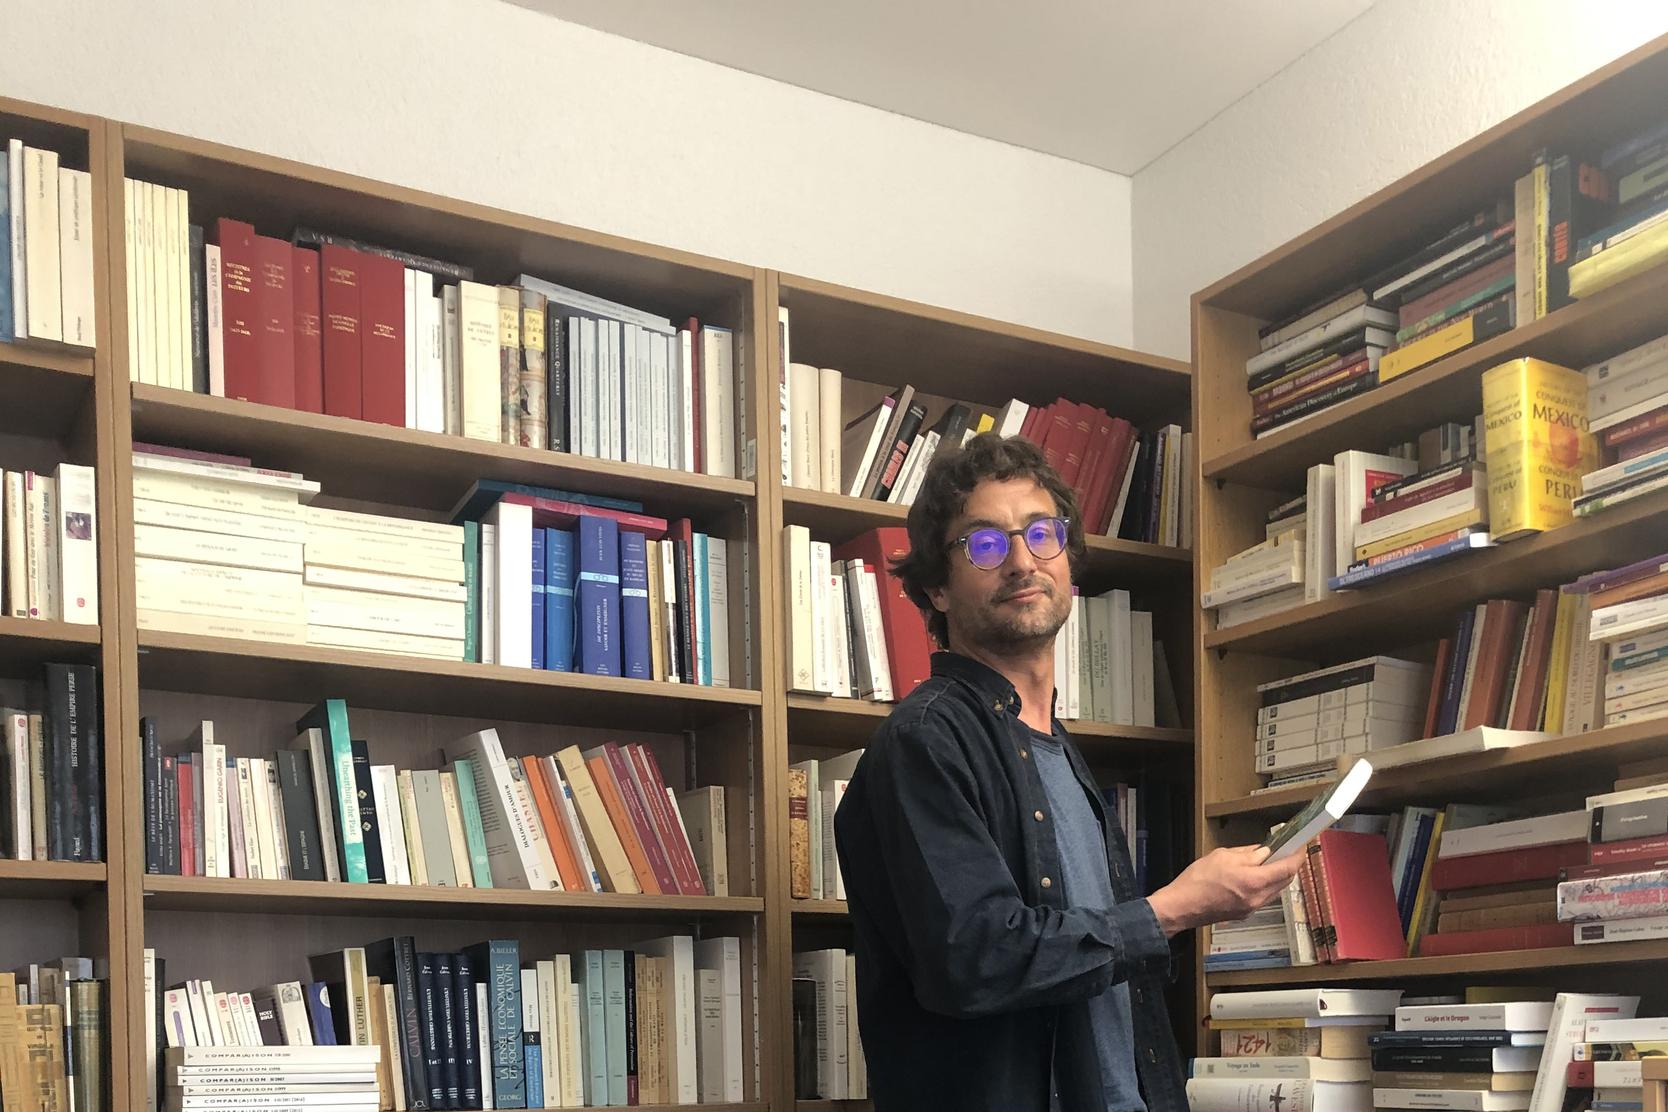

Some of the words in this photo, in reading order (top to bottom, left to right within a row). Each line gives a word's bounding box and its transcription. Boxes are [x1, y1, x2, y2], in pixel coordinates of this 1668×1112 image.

[1485, 410, 1522, 431] MEXICO
[1533, 403, 1590, 432] MEXICO
[67, 671, 76, 692] PERSE
[69, 725, 77, 735] DE
[69, 737, 79, 767] HISTOIRE
[342, 760, 354, 804] Unearthing
[505, 783, 519, 813] D'AMOUR
[347, 806, 355, 818] the
[347, 818, 356, 836] Past
[516, 813, 530, 848] DIALOGUES
[406, 971, 414, 1000] BERNARD
[504, 963, 515, 1001] CALVIN
[355, 995, 365, 1030] LUTHER
[507, 1005, 515, 1018] DE
[1451, 1014, 1470, 1024] Dragon
[405, 1006, 421, 1058] CALVIN
[507, 1025, 517, 1064] SOCIALE
[1236, 1031, 1271, 1056] 1421
[500, 1068, 509, 1080] LA
[509, 1067, 518, 1079] ET
